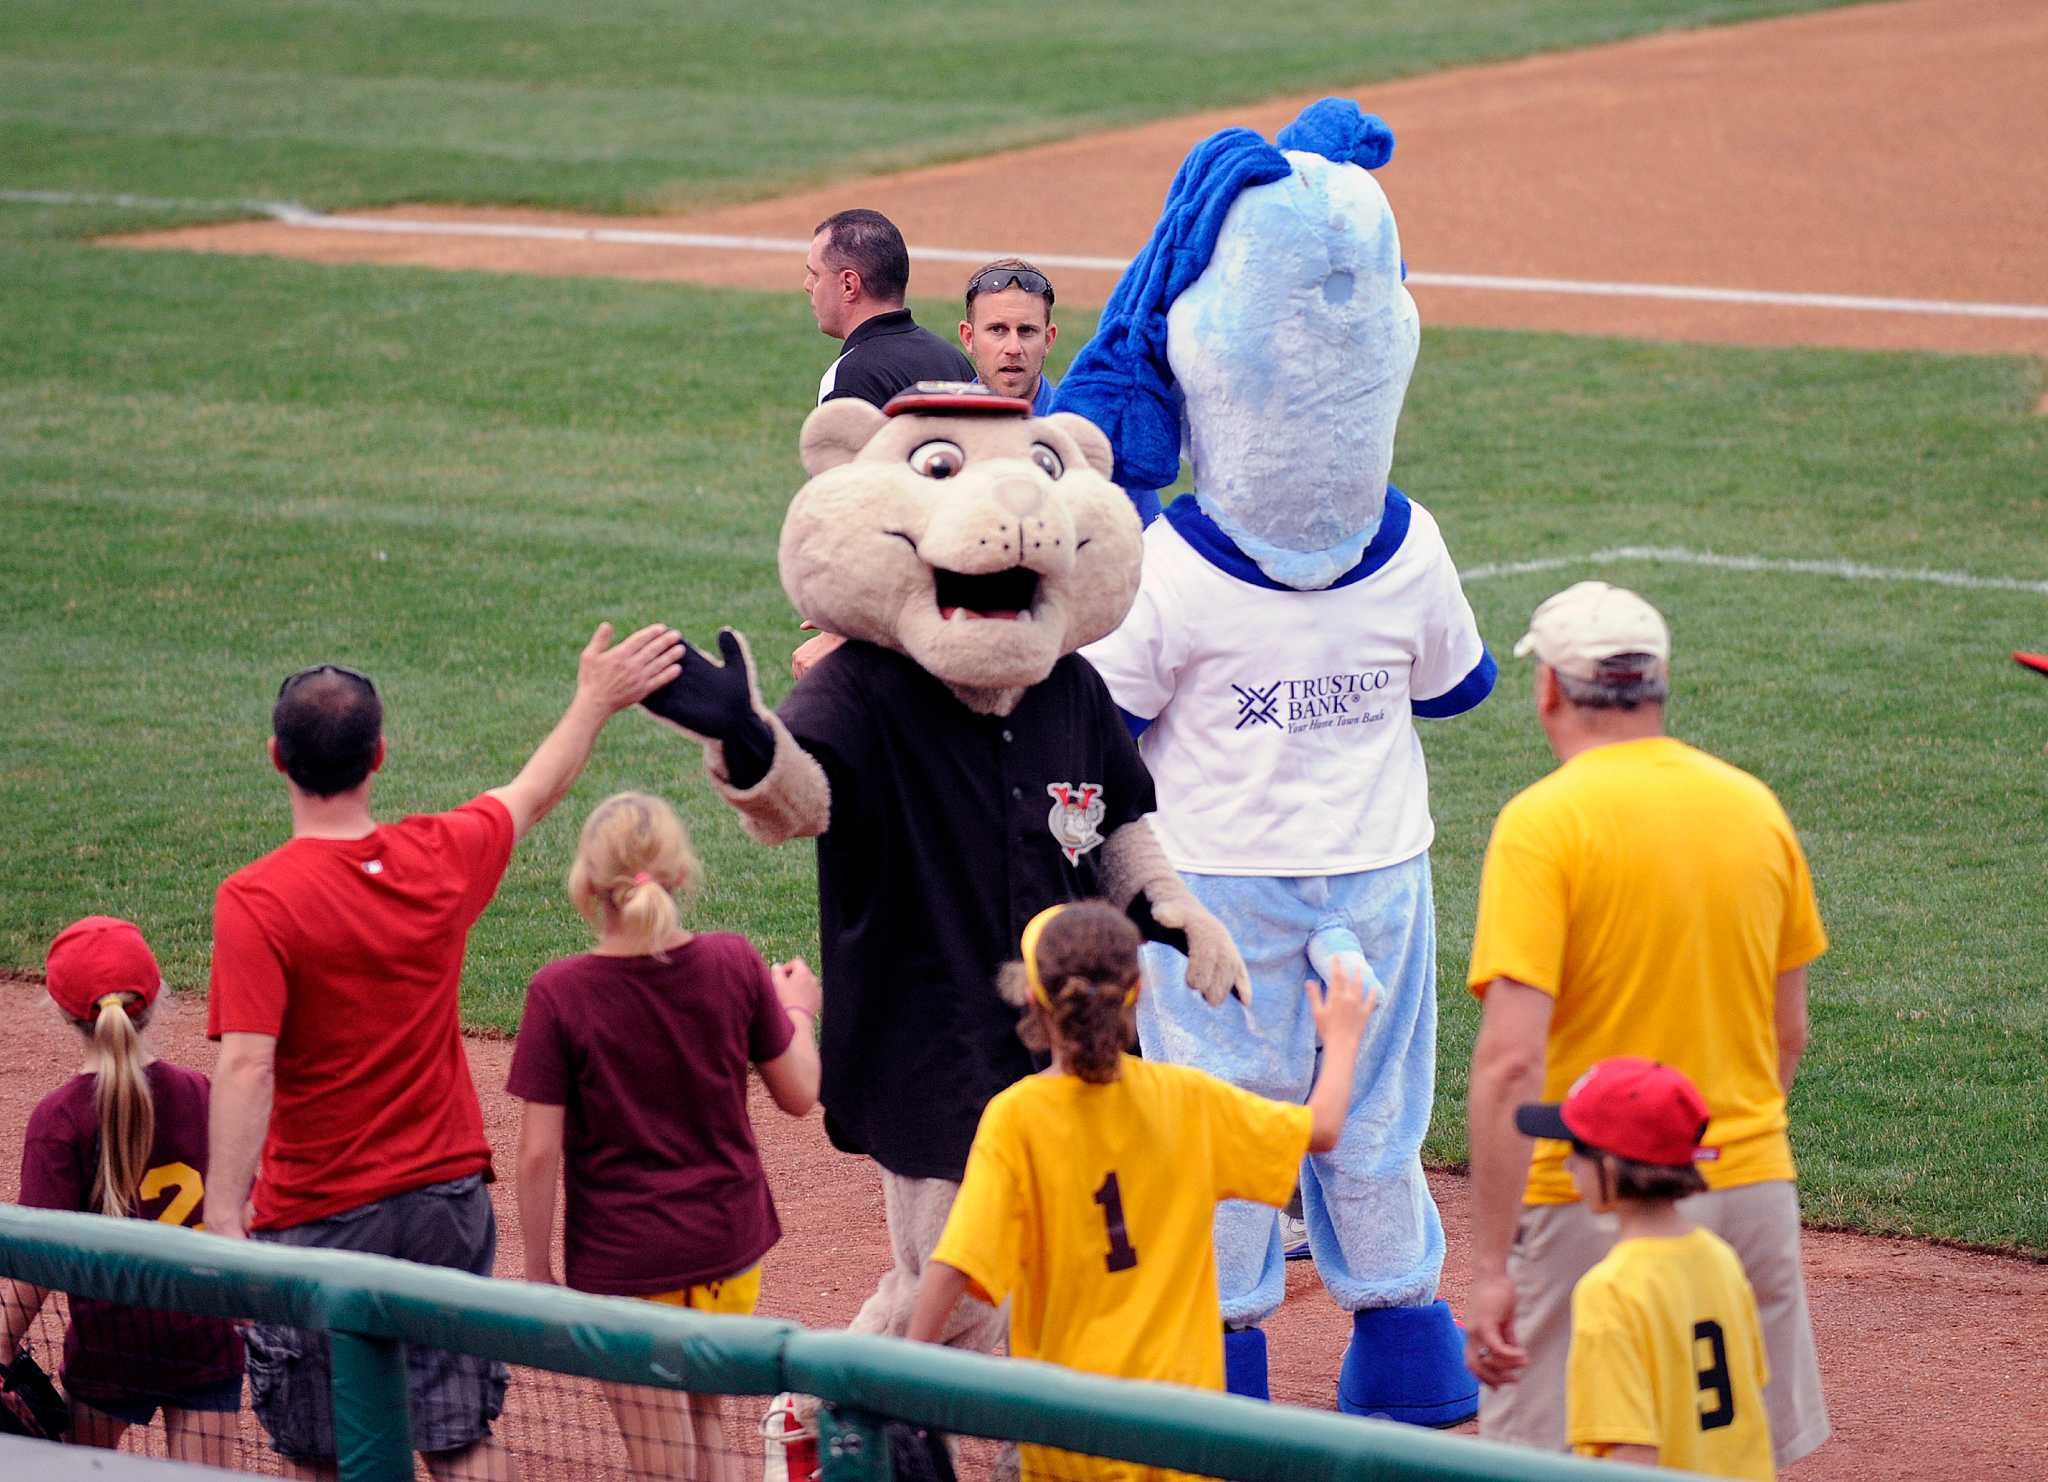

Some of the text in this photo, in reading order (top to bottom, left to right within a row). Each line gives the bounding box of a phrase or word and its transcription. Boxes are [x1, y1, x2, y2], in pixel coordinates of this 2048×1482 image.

[1283, 670, 1389, 700] TRUSTCO
[1288, 708, 1385, 734] Your Home Town Bank
[139, 1161, 208, 1231] 2
[1093, 1171, 1138, 1273] 1
[1694, 1320, 1734, 1431] 3
